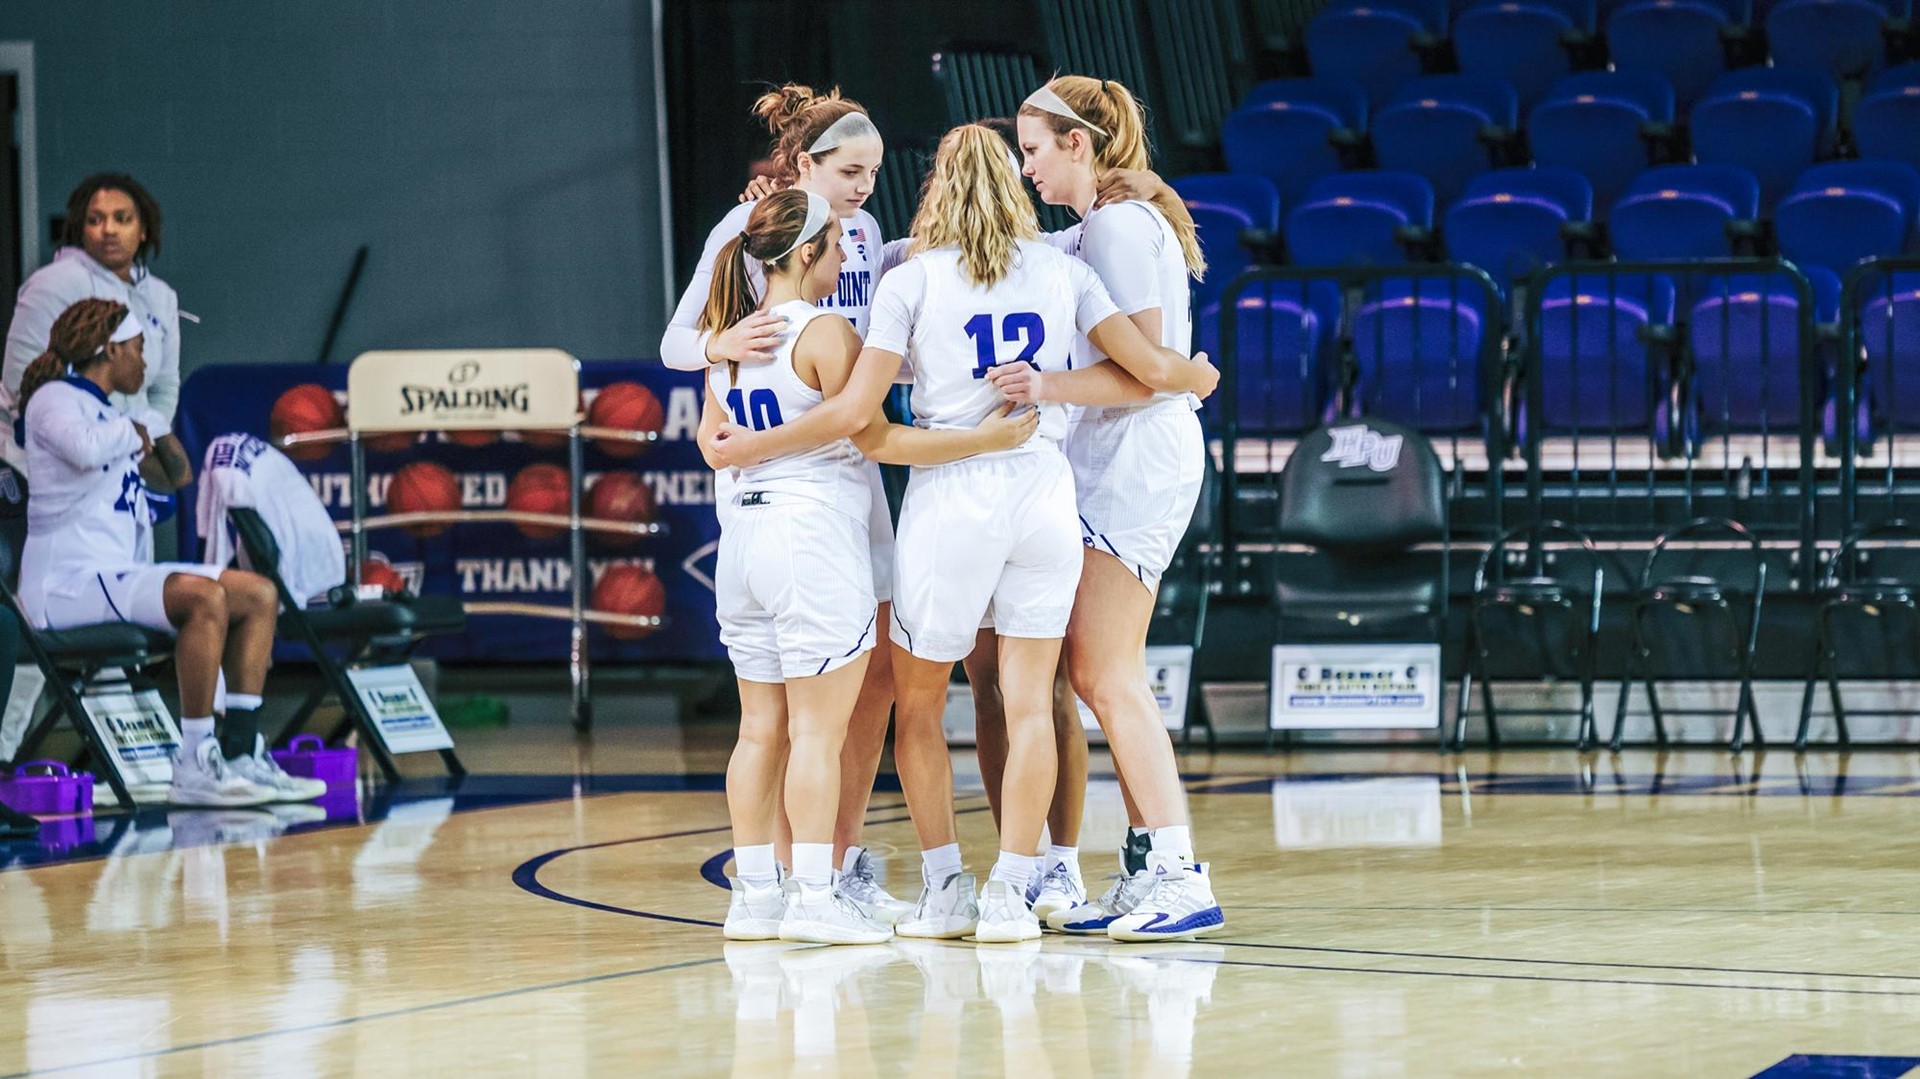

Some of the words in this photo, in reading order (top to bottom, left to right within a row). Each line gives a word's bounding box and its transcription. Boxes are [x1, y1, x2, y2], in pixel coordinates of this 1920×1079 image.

[827, 270, 871, 308] OINT
[963, 311, 1046, 380] 12
[400, 382, 529, 415] SPALDING
[726, 388, 785, 432] 10
